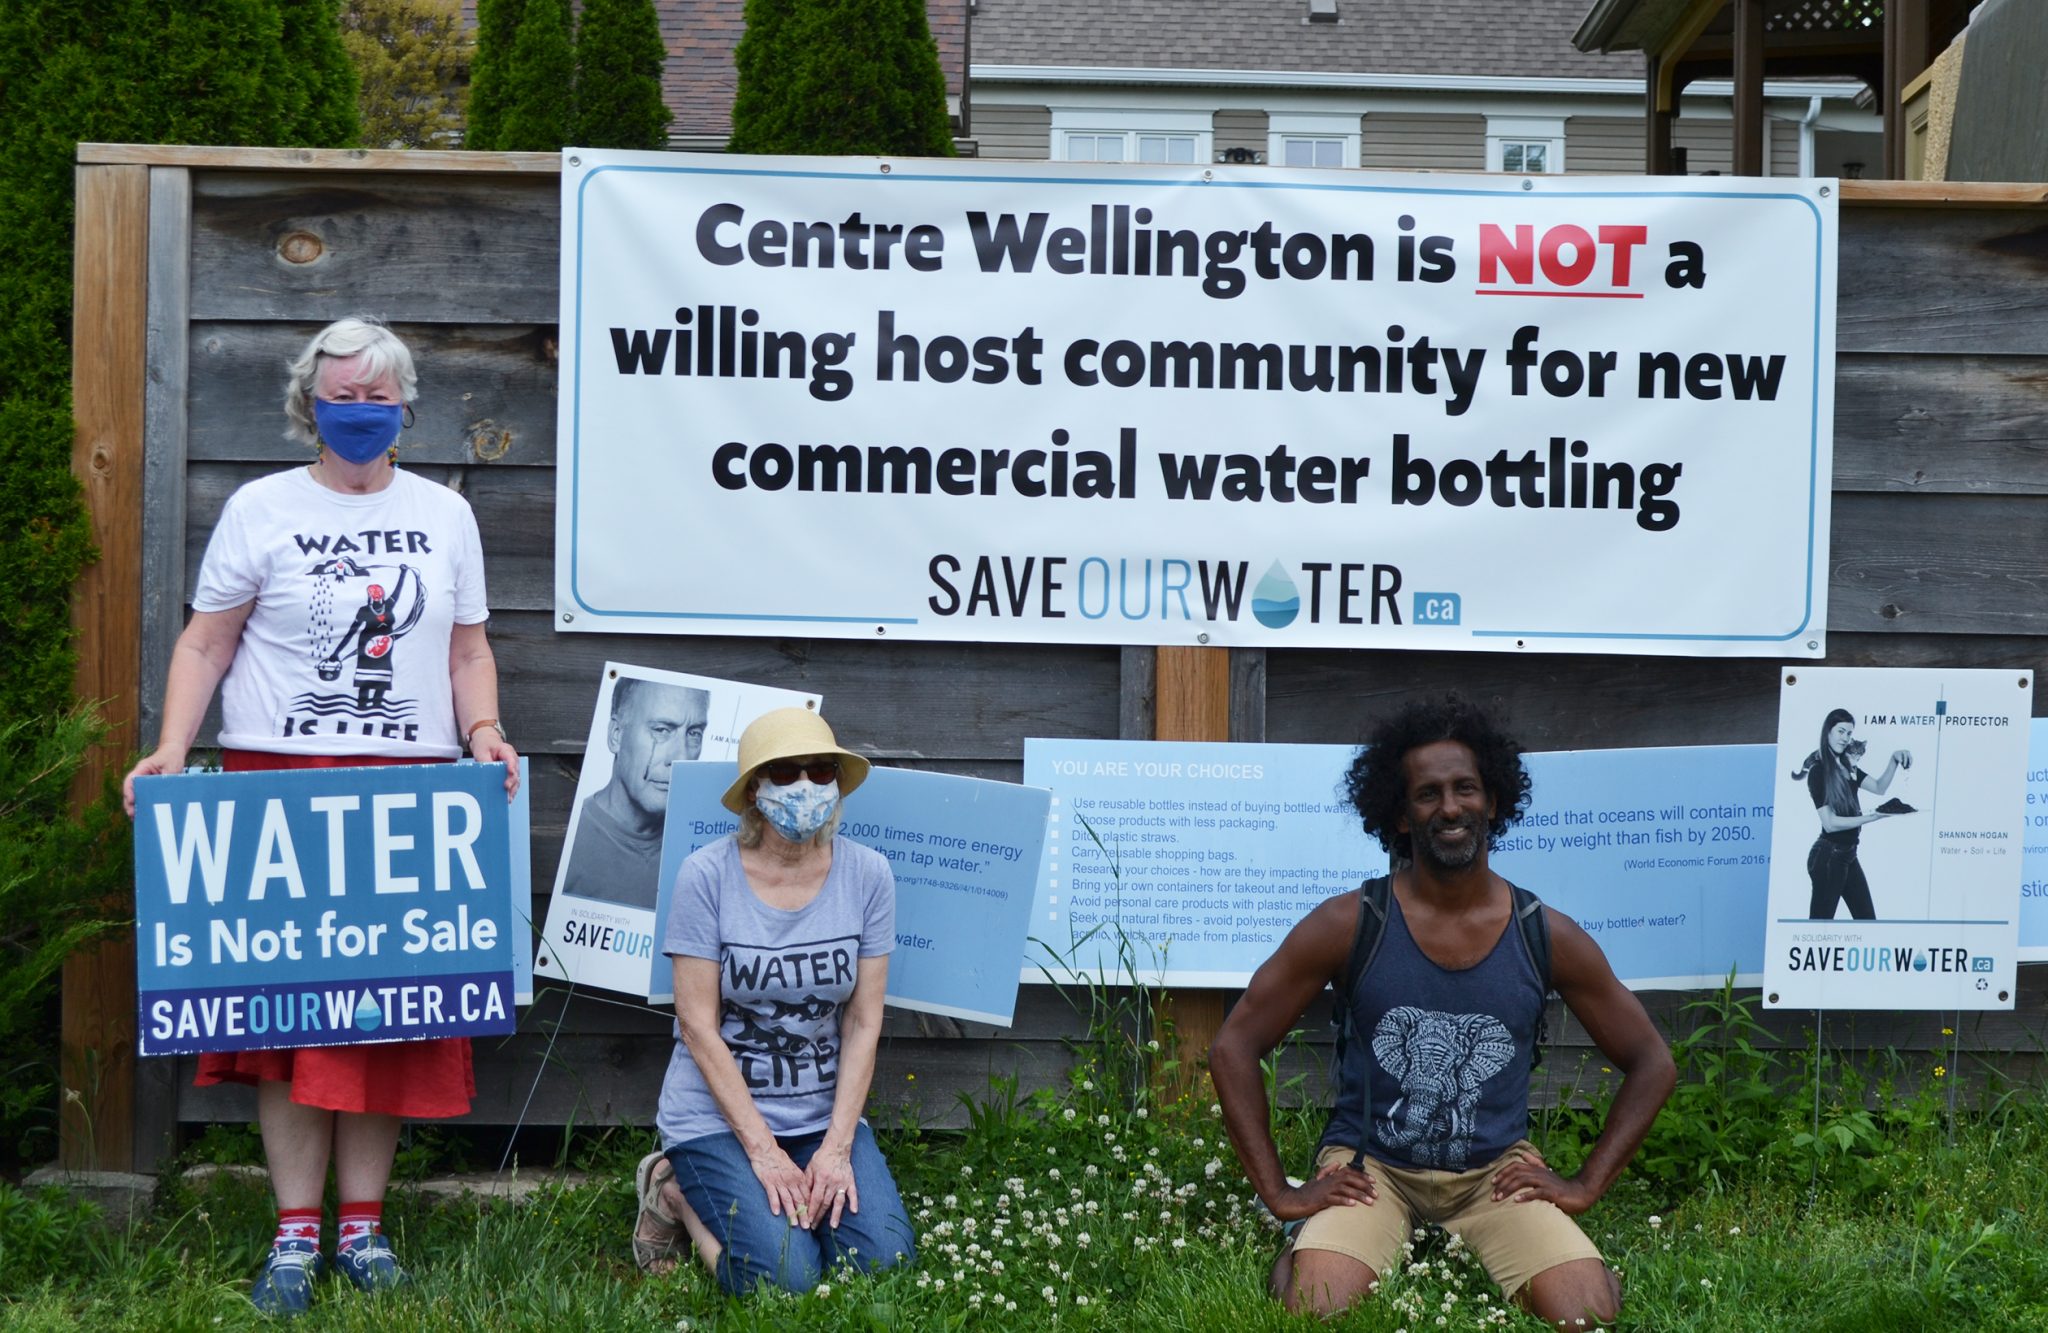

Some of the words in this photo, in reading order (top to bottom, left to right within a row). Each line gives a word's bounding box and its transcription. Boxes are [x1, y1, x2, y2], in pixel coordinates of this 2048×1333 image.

[695, 203, 944, 272] Centre
[966, 204, 1374, 299] Wellington
[1397, 214, 1456, 283] is
[1479, 223, 1648, 287] NOT
[1664, 240, 1707, 289] a
[610, 305, 856, 401] willing
[877, 310, 1043, 385] host
[1064, 324, 1487, 416] community
[1506, 325, 1617, 398] for
[1638, 350, 1787, 401] new
[712, 427, 1137, 499] commercial
[1159, 444, 1370, 502] water
[1391, 433, 1683, 531] bottling
[293, 530, 432, 556] WATER
[1871, 715, 1886, 725] AM
[1890, 716, 1897, 725] A
[1900, 716, 1935, 725] WATER
[1945, 716, 2009, 726] PROTECTOR
[1052, 760, 1088, 776] YOU
[1094, 761, 1128, 777] ARE
[1134, 762, 1182, 779] YOUR
[1188, 763, 1264, 780] CHOICES
[1074, 798, 1095, 809] Use
[1099, 799, 1145, 810] reusable
[1149, 800, 1185, 810] bottles
[1188, 801, 1227, 811] instead
[1231, 801, 1242, 812] of
[1245, 802, 1280, 814] buying
[1284, 802, 1320, 813] bottled
[1324, 803, 1350, 814] wate
[1565, 810, 1593, 824] that
[1598, 810, 1655, 824] oceans
[1660, 805, 1684, 821] will
[1690, 804, 1746, 820] contain
[1752, 806, 1774, 818] mo
[1073, 814, 1115, 825] Choose
[1119, 816, 1166, 828] products
[1169, 816, 1190, 827] with
[1194, 817, 1215, 828] less
[1219, 817, 1278, 831] packaging.
[838, 822, 880, 838] 2,000
[885, 826, 924, 843] times
[929, 833, 966, 849] more
[971, 841, 1023, 862] energy
[1103, 831, 1138, 844] plastic
[1141, 832, 1179, 843] straws.
[1538, 835, 1556, 852] by
[1561, 832, 1612, 850] weight
[1616, 830, 1650, 845] than
[1656, 828, 1682, 843] fish
[1688, 828, 1706, 845] by
[1711, 826, 1755, 841] 2050.
[1939, 831, 1978, 839] SHANNON
[153, 791, 487, 904] WATER
[1072, 846, 1101, 860] Carry
[1104, 848, 1151, 859] reusable
[1155, 849, 1205, 862] shopping
[1208, 849, 1237, 862] bags.
[911, 851, 934, 867] tap
[1624, 859, 1655, 871] (World
[1658, 857, 1704, 868] Economic
[1707, 856, 1738, 866] Forum
[1740, 855, 1765, 864] 2016
[1125, 866, 1148, 876] your
[1151, 865, 1189, 876] choices
[1200, 866, 1222, 876] how
[1225, 868, 1241, 877] are
[1244, 867, 1266, 879] they
[1270, 867, 1319, 880] impacting
[1322, 868, 1338, 879] the
[1341, 868, 1379, 881] planet?
[1072, 880, 1100, 892] Bring
[1104, 882, 1128, 893] your
[1131, 883, 1153, 892] own
[1157, 881, 1213, 893] containers
[1217, 882, 1231, 893] for
[1235, 882, 1274, 894] takeout
[1278, 883, 1298, 894] and
[1070, 896, 1100, 907] Avoid
[1104, 897, 1151, 909] personal
[1155, 900, 1178, 908] care
[1182, 898, 1228, 910] products
[1233, 900, 1254, 909] with
[1257, 900, 1293, 912] plastic
[1070, 912, 1098, 923] Seek
[1101, 913, 1119, 923] out
[1122, 913, 1159, 924] natural
[1163, 913, 1192, 924] fibres
[1203, 915, 1233, 925] avoid
[1584, 920, 1604, 932] buy
[1607, 917, 1644, 929] bottled
[1648, 914, 1686, 926] water?
[155, 922, 192, 966] Is
[211, 917, 302, 964] Not
[316, 910, 387, 958] for
[402, 904, 498, 954] Sale
[1149, 931, 1166, 940] are
[1170, 931, 1200, 941] made
[1203, 931, 1228, 942] from
[1231, 932, 1275, 944] plastics.
[730, 948, 852, 991] WATER
[741, 1055, 836, 1089] LIFE
